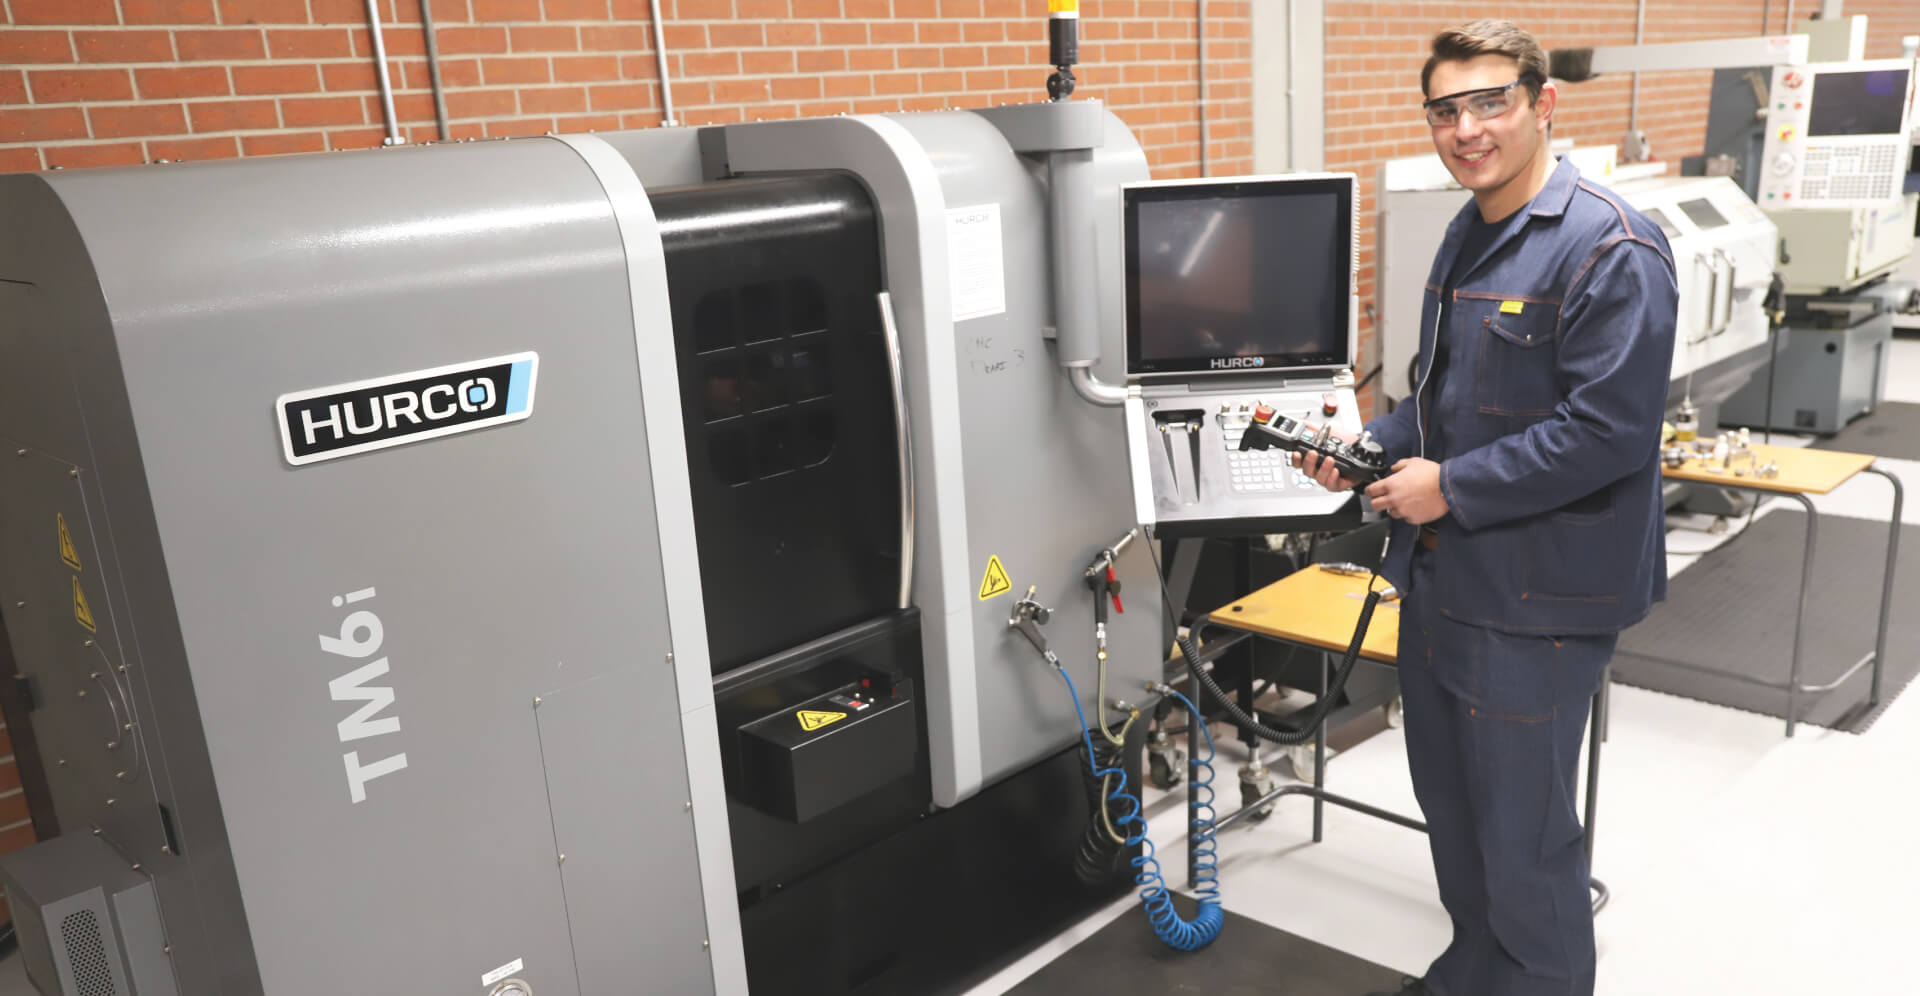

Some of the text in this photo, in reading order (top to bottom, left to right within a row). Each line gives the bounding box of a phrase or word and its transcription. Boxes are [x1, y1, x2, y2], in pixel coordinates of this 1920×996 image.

[1210, 356, 1264, 369] HURCO
[301, 377, 497, 445] HURCO
[318, 586, 408, 804] TM6i
